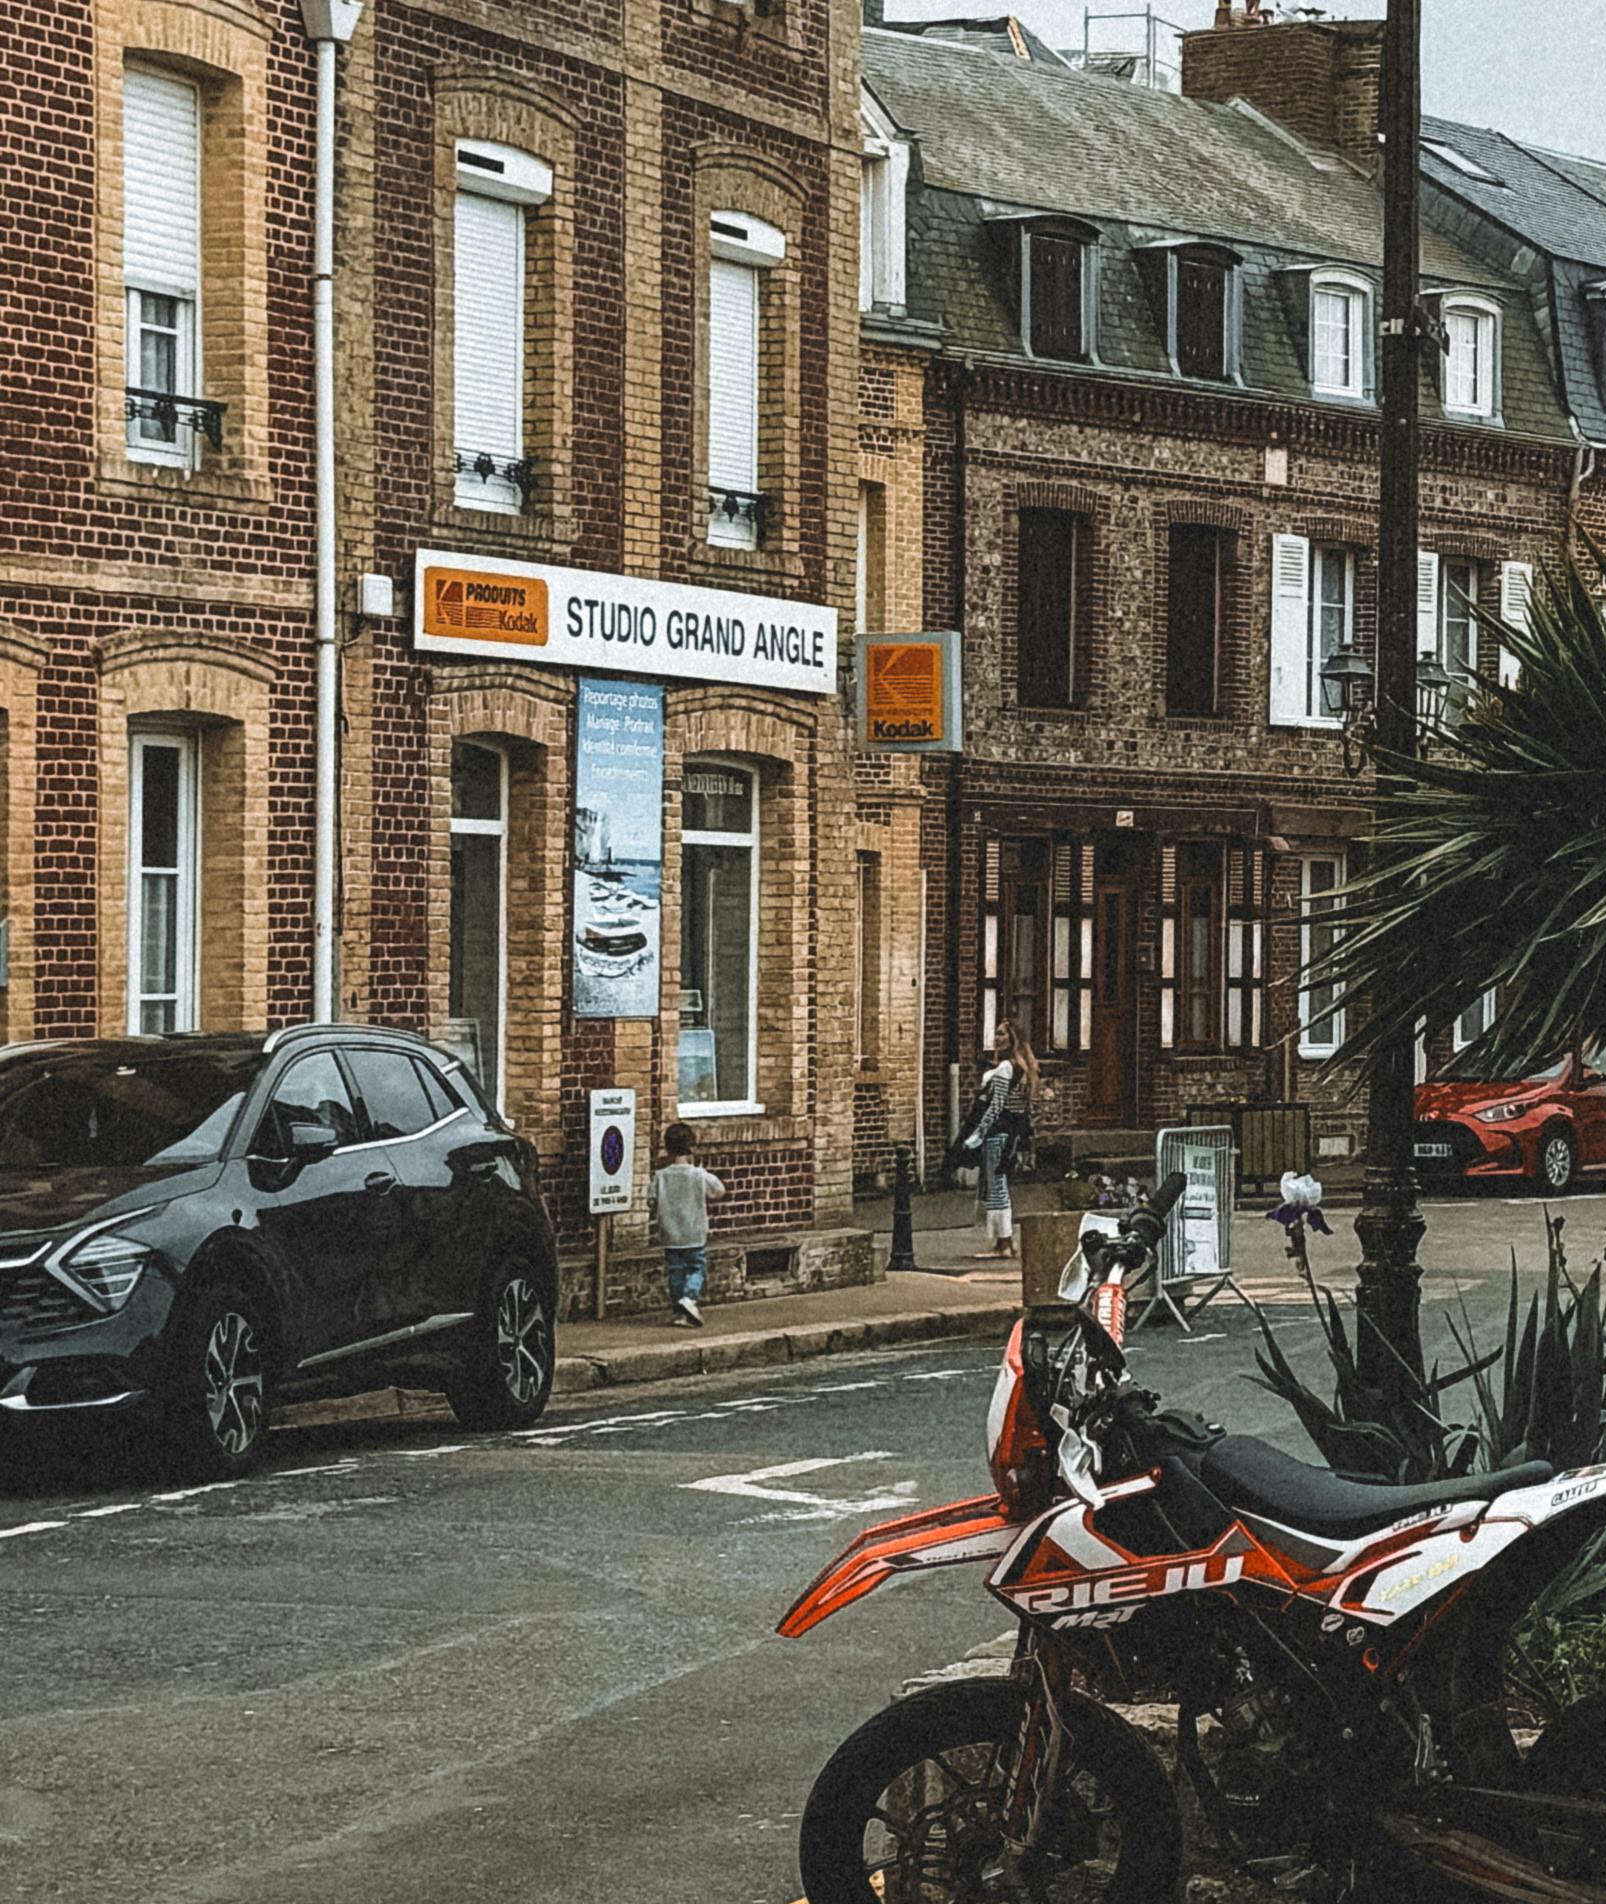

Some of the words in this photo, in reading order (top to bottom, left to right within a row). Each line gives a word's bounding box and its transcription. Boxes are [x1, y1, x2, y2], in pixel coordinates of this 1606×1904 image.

[465, 583, 526, 607] PRODUITS
[500, 610, 538, 634] Kodak
[566, 596, 657, 647] STUDIO
[666, 610, 745, 657] GRAND
[753, 623, 825, 668] ANGLE
[873, 719, 934, 738] Kodak
[1012, 1555, 1245, 1615] RIEJU
